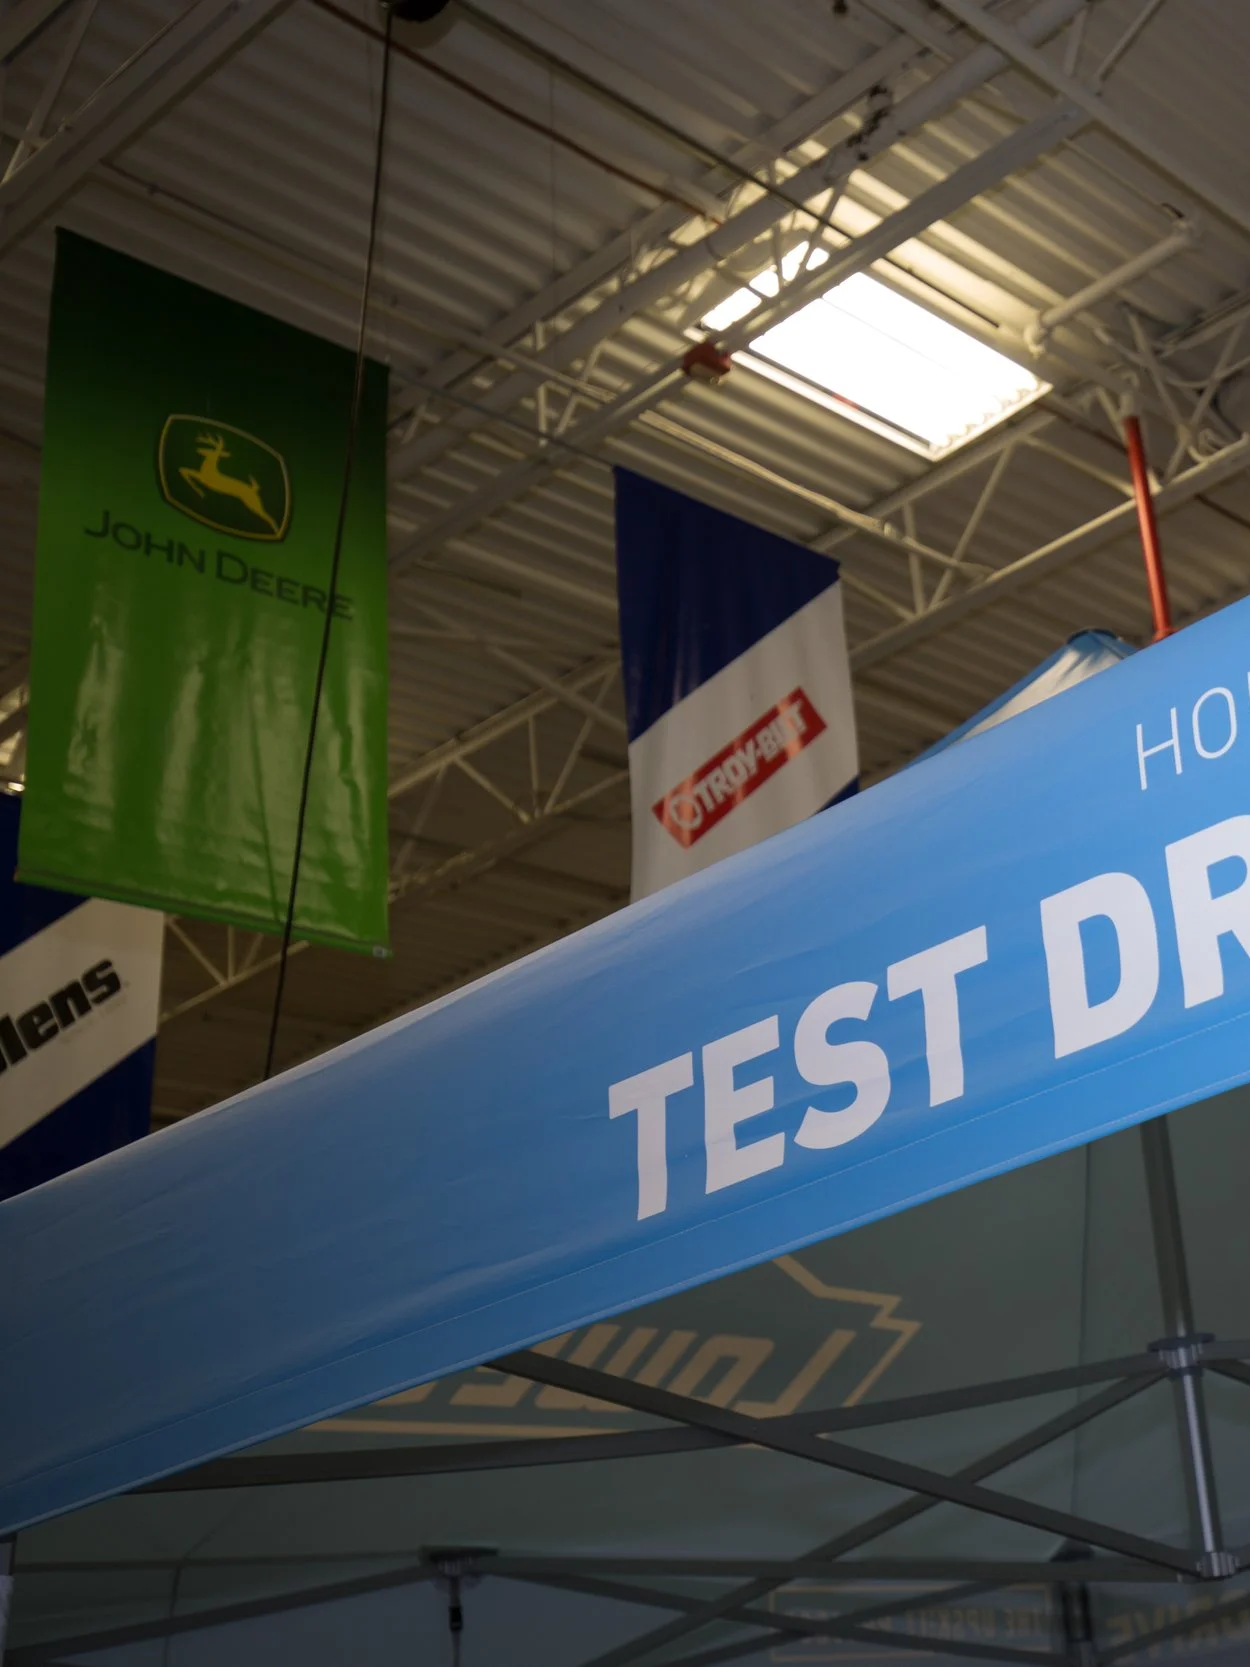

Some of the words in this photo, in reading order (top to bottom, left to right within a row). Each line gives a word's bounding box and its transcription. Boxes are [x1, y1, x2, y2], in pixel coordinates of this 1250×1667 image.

[83, 510, 205, 575] JOHN
[215, 549, 354, 621] DEERE
[0, 958, 121, 1073] lens
[607, 924, 989, 1222] TEST
